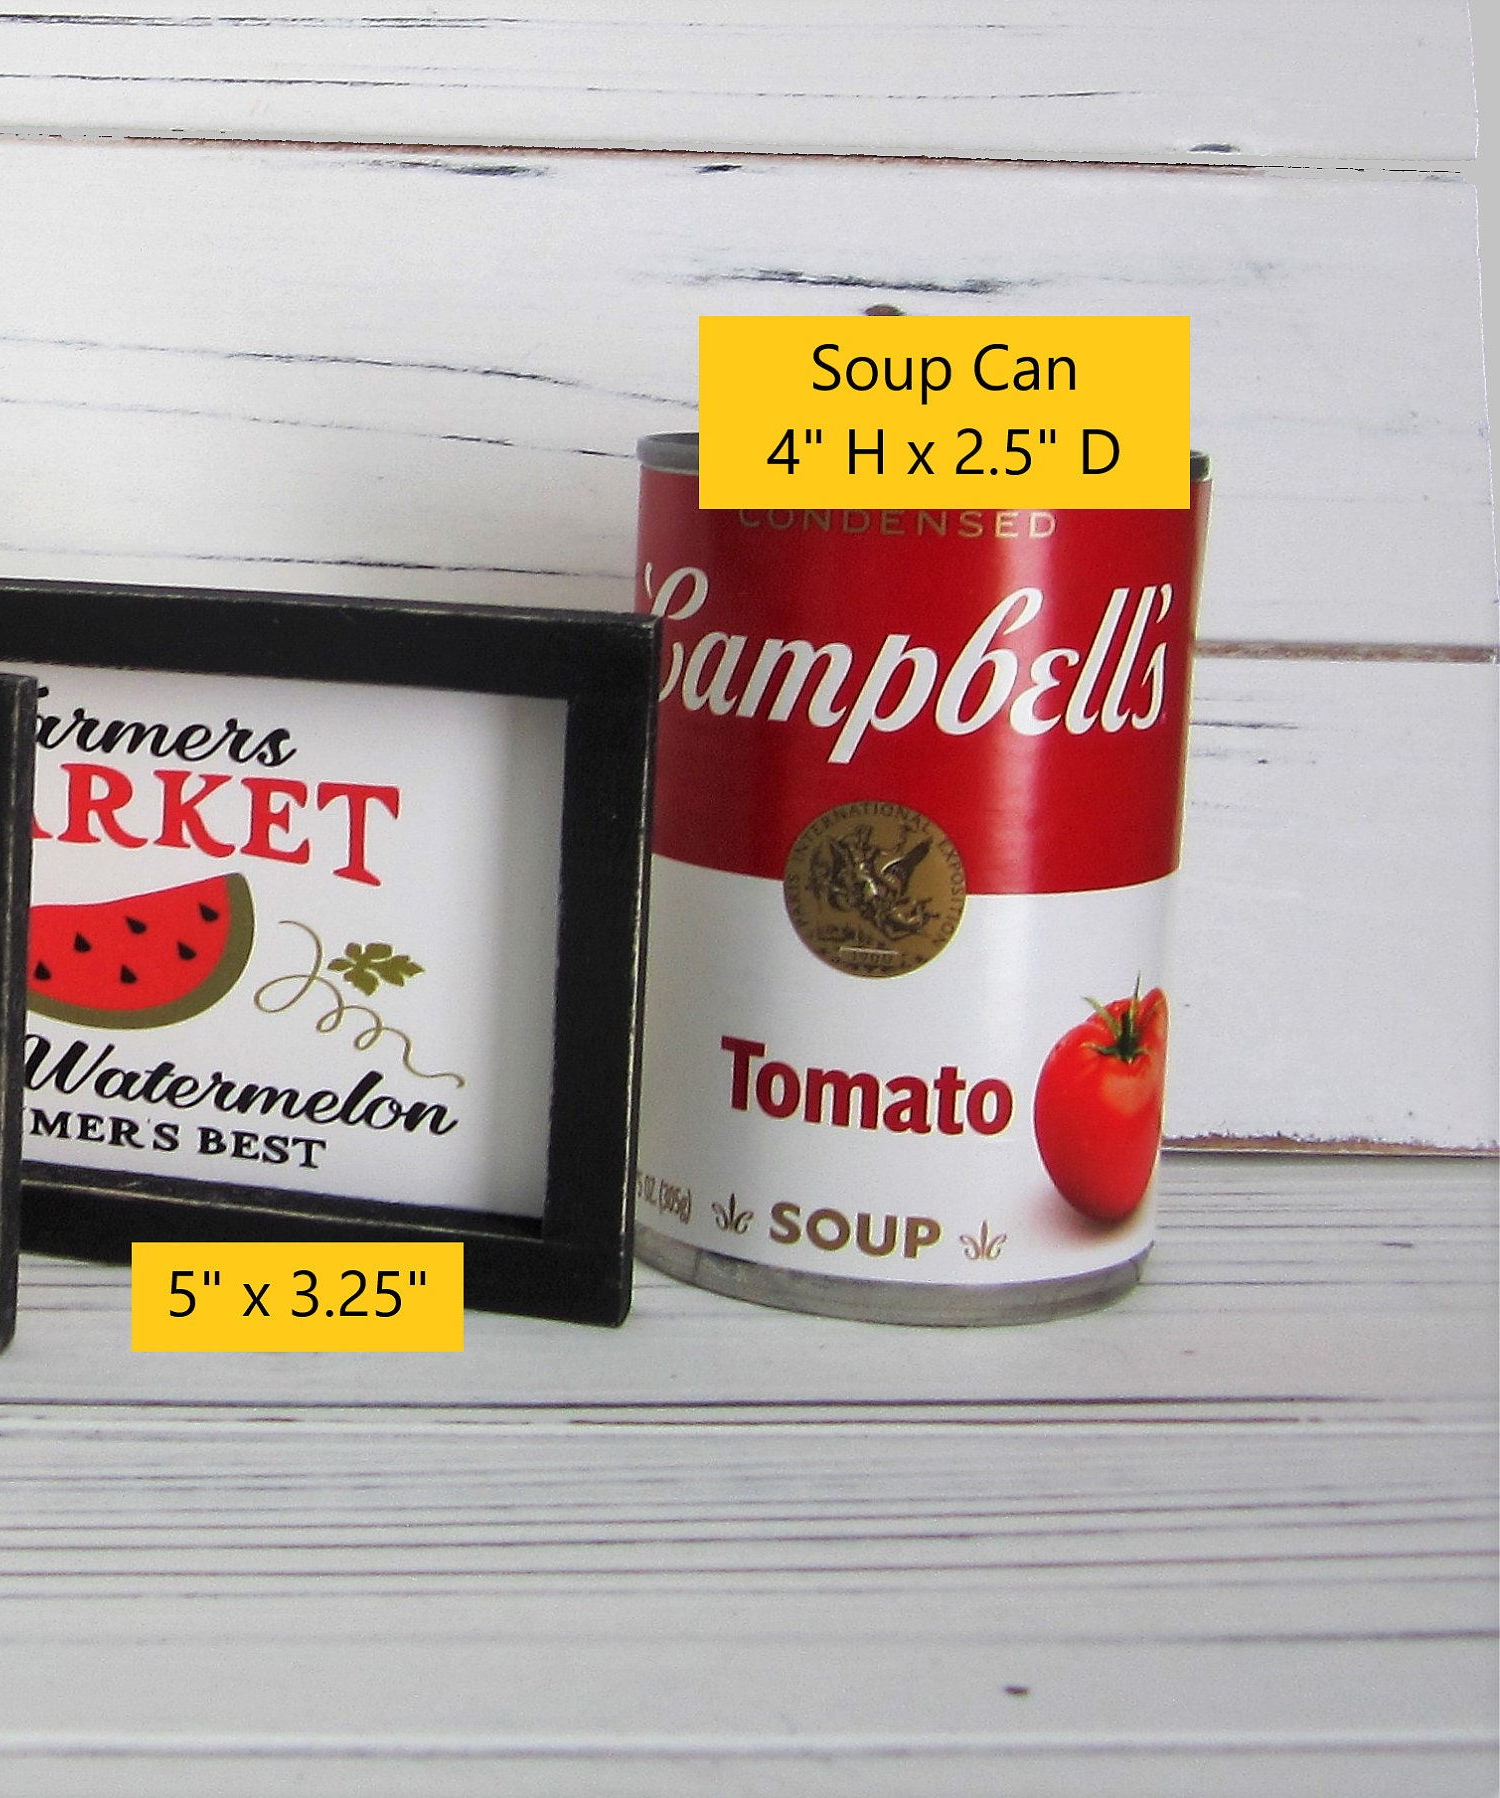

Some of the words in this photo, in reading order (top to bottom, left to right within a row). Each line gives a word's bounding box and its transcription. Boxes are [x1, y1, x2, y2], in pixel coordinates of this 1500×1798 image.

[738, 508, 1057, 539] CONDENSED
[644, 562, 1173, 764] Campbell's
[37, 686, 297, 767] armers
[32, 763, 400, 887] RKET
[24, 1033, 459, 1136] Watermelon
[721, 1035, 1014, 1136] Tomato
[22, 1106, 180, 1152] MER'S
[196, 1126, 327, 1170] BEST
[769, 1201, 942, 1259] SOUP
